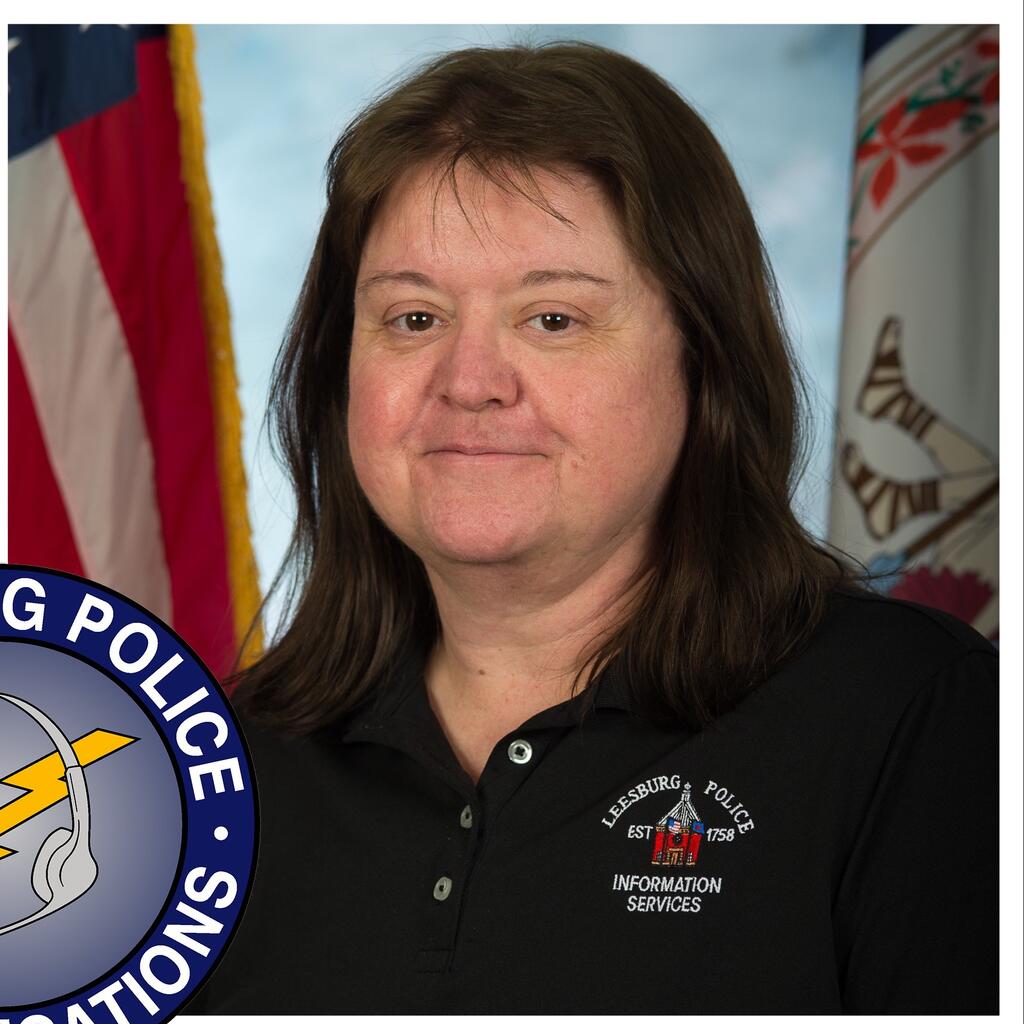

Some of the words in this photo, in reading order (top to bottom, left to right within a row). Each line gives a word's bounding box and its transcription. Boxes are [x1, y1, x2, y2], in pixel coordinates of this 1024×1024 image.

[602, 775, 681, 829] LEESBURG
[704, 780, 755, 834] POLICE
[628, 825, 653, 839] EST
[706, 828, 735, 842] 1758
[612, 874, 722, 893] INFORMATION
[627, 895, 702, 912] SERVICES
